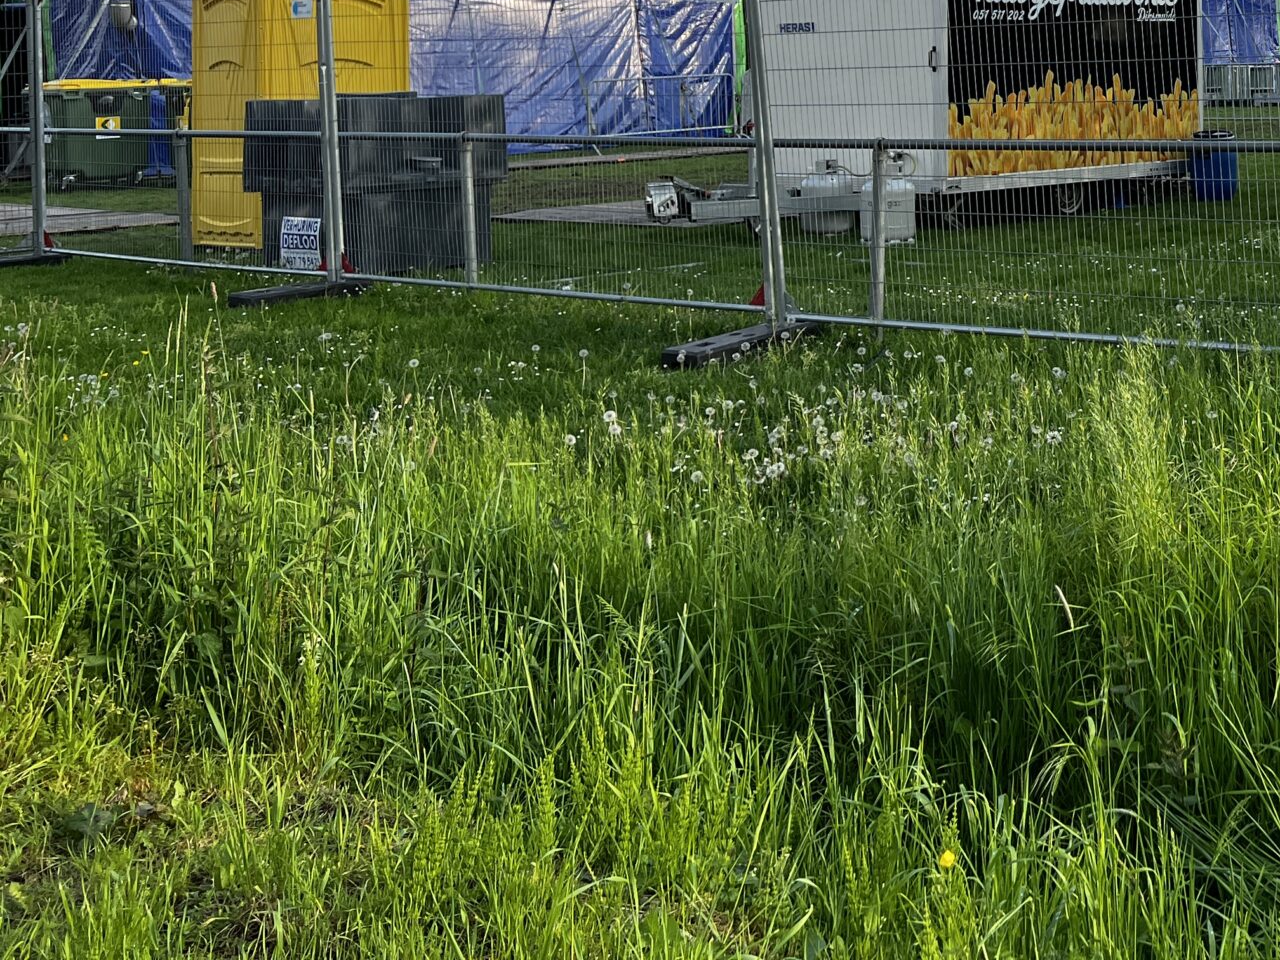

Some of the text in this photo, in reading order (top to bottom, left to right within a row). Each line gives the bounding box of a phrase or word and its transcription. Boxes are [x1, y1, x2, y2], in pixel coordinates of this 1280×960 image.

[972, 9, 1025, 21] 051 511 202
[283, 234, 317, 249] DEFLOO
